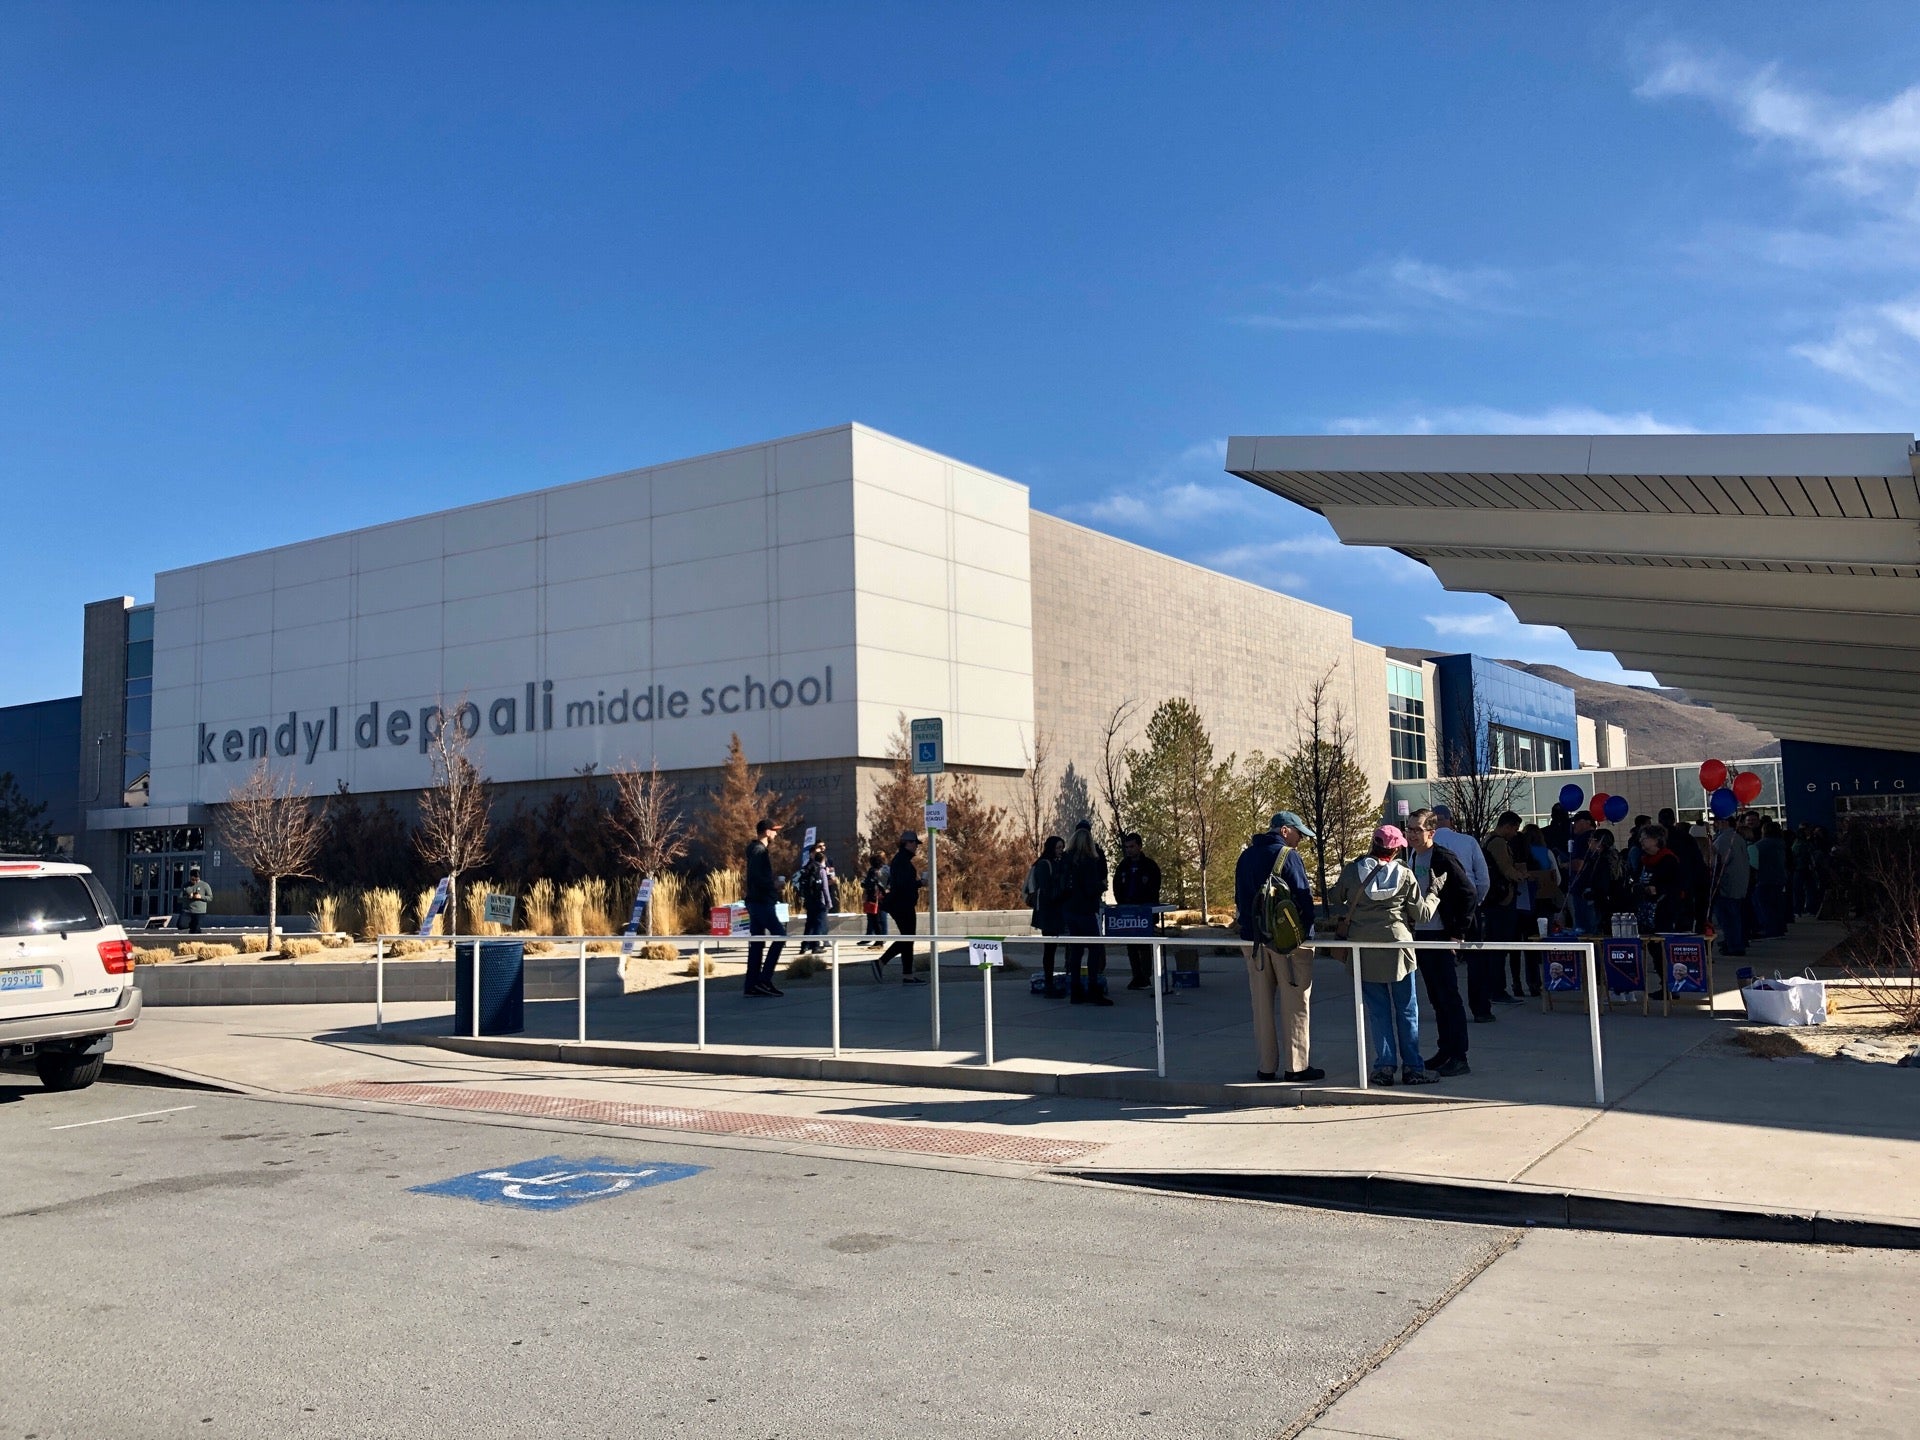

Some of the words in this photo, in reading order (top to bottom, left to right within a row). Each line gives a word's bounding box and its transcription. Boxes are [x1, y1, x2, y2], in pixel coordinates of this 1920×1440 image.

[198, 705, 338, 765] kendyl
[355, 679, 553, 754] depoali
[566, 684, 689, 727] middle
[701, 665, 833, 716] school
[913, 723, 941, 731] RESERVED
[915, 732, 940, 740] PARKING
[1807, 778, 1905, 792] entra
[712, 921, 729, 929] DEBT
[1108, 915, 1149, 929] Bernie
[972, 943, 999, 951] CAUCUS
[1674, 955, 1698, 963] LEAD
